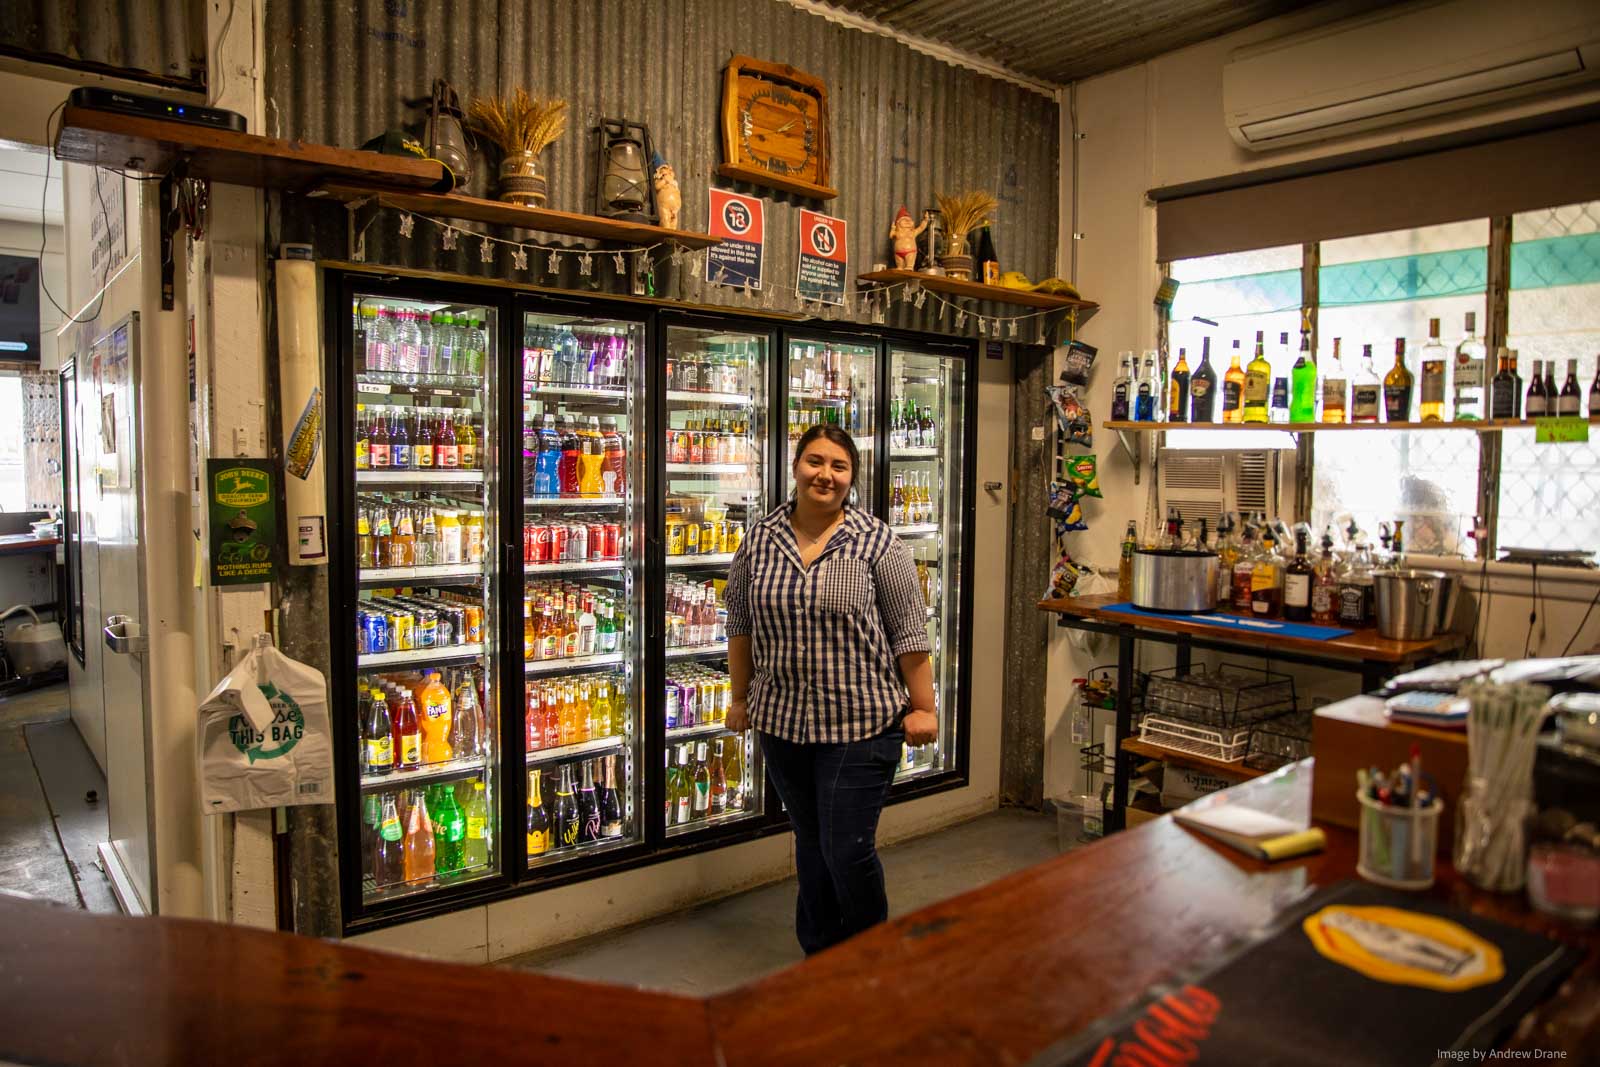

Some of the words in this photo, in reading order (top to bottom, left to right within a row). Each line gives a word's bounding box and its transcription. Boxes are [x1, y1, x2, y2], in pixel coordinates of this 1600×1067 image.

[729, 212, 745, 228] 18
[718, 254, 736, 262] against
[801, 269, 816, 277] anyone
[816, 266, 834, 275] supplied
[808, 276, 822, 284] against
[219, 470, 239, 481] JOHN
[241, 470, 265, 480] DEERE
[217, 563, 251, 571] NOTHING
[252, 562, 272, 570] RUNS
[231, 730, 265, 744] THIS
[272, 725, 303, 741] BAG
